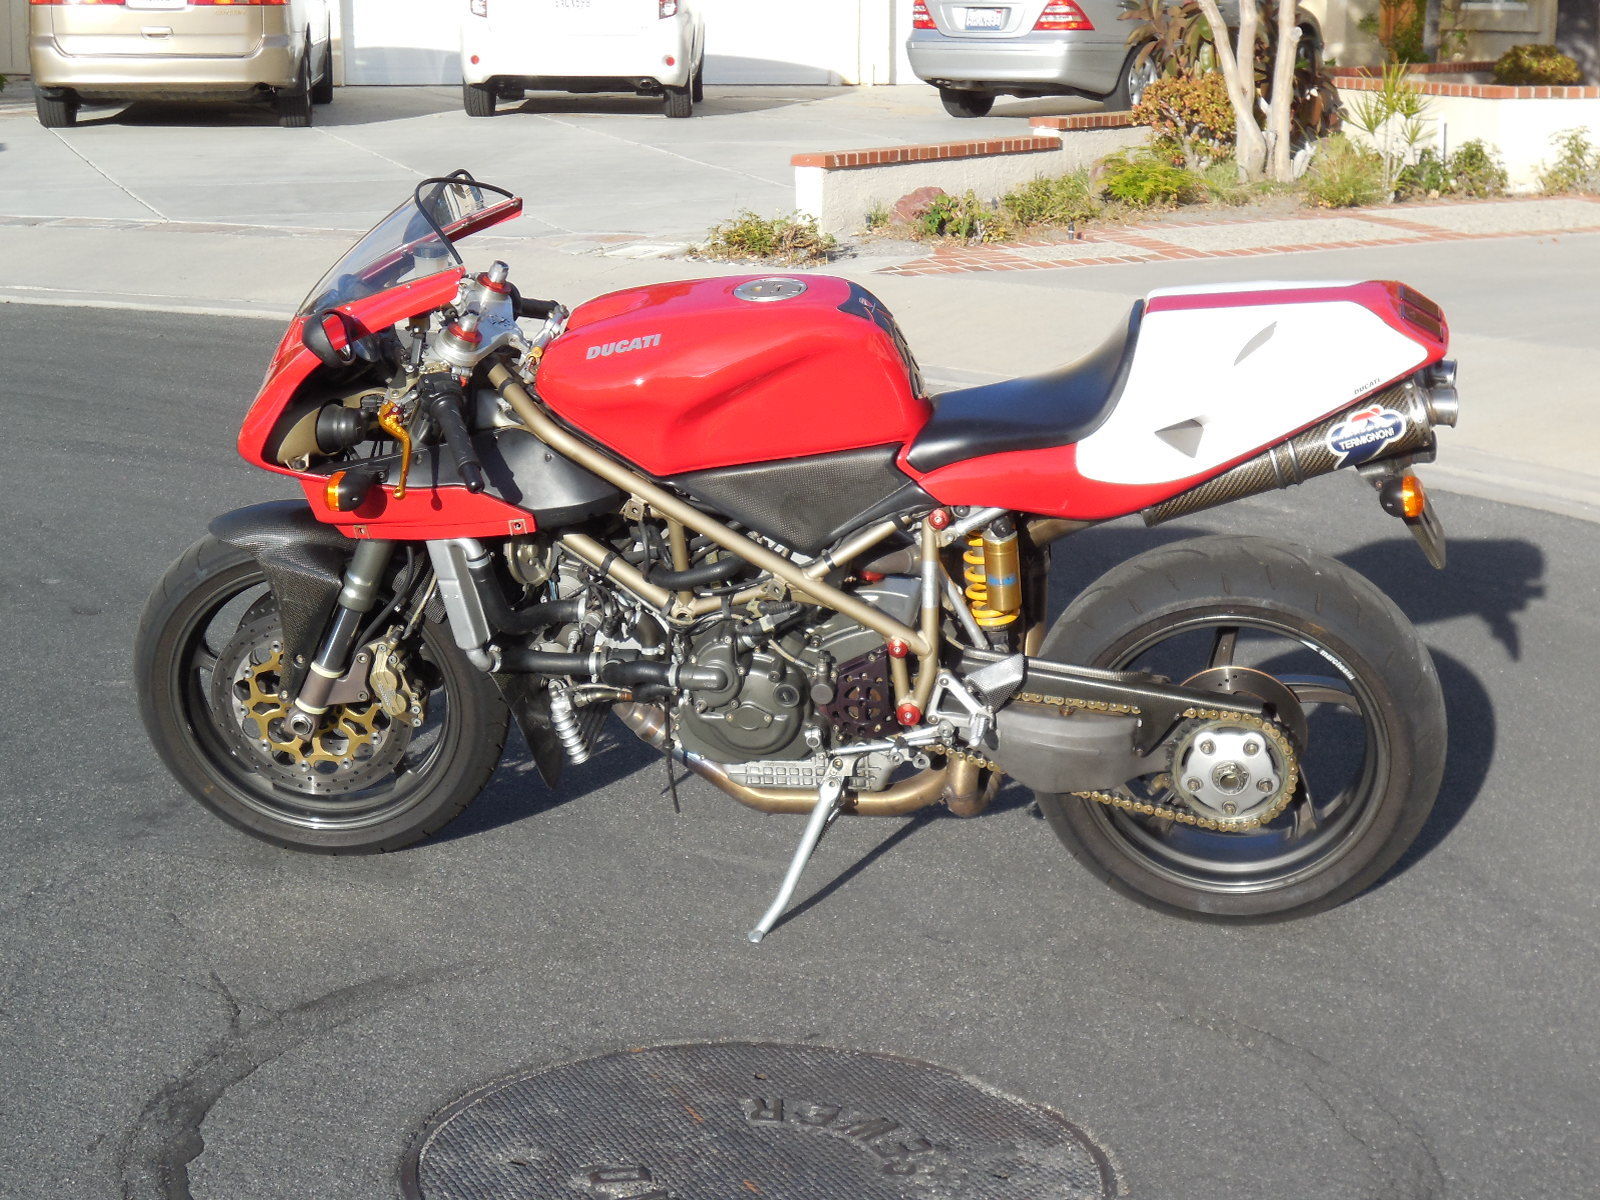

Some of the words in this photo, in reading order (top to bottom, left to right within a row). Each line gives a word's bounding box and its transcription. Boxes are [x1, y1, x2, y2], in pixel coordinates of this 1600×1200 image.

[586, 334, 662, 360] DUCATI
[1354, 378, 1381, 395] DUCATI
[1339, 427, 1395, 450] TERMIGNONI
